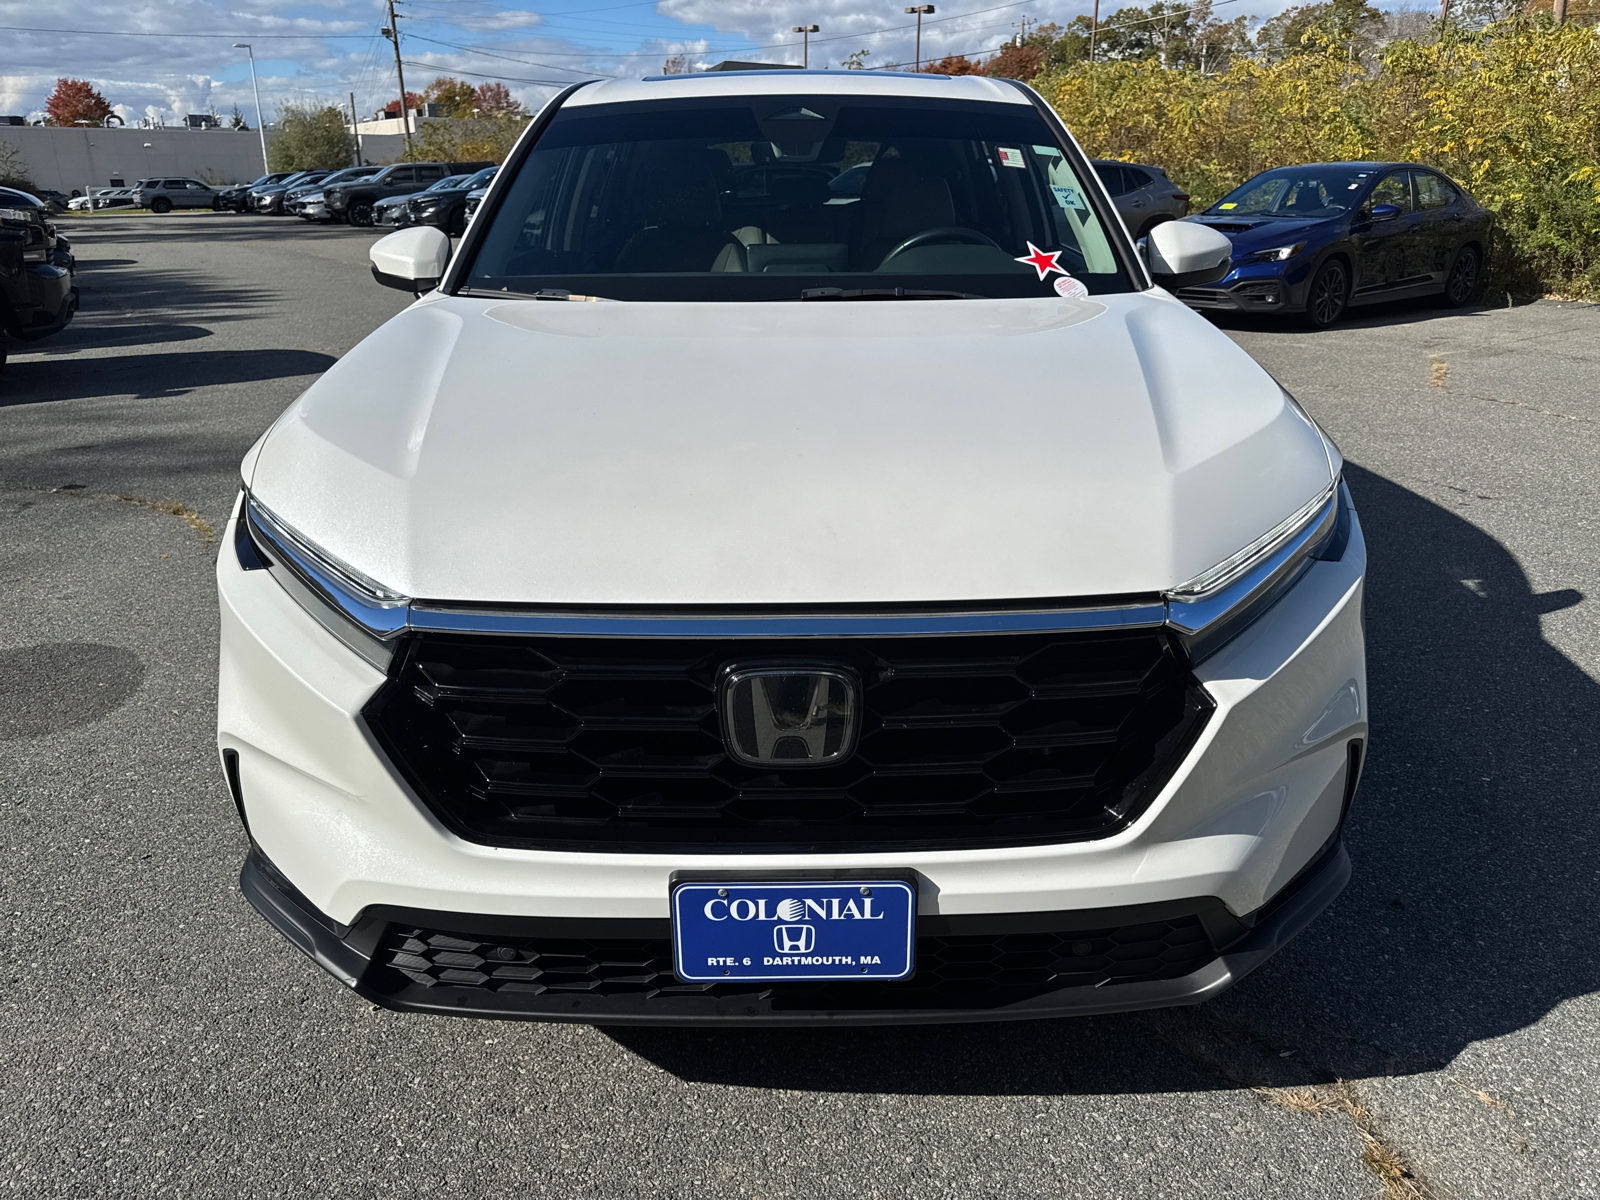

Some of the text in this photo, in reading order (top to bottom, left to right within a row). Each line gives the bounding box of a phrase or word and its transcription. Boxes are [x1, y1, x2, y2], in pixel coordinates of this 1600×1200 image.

[704, 897, 884, 922] COLONIAL
[707, 955, 881, 966] RTE. 6 DARTMOUTH, MA
